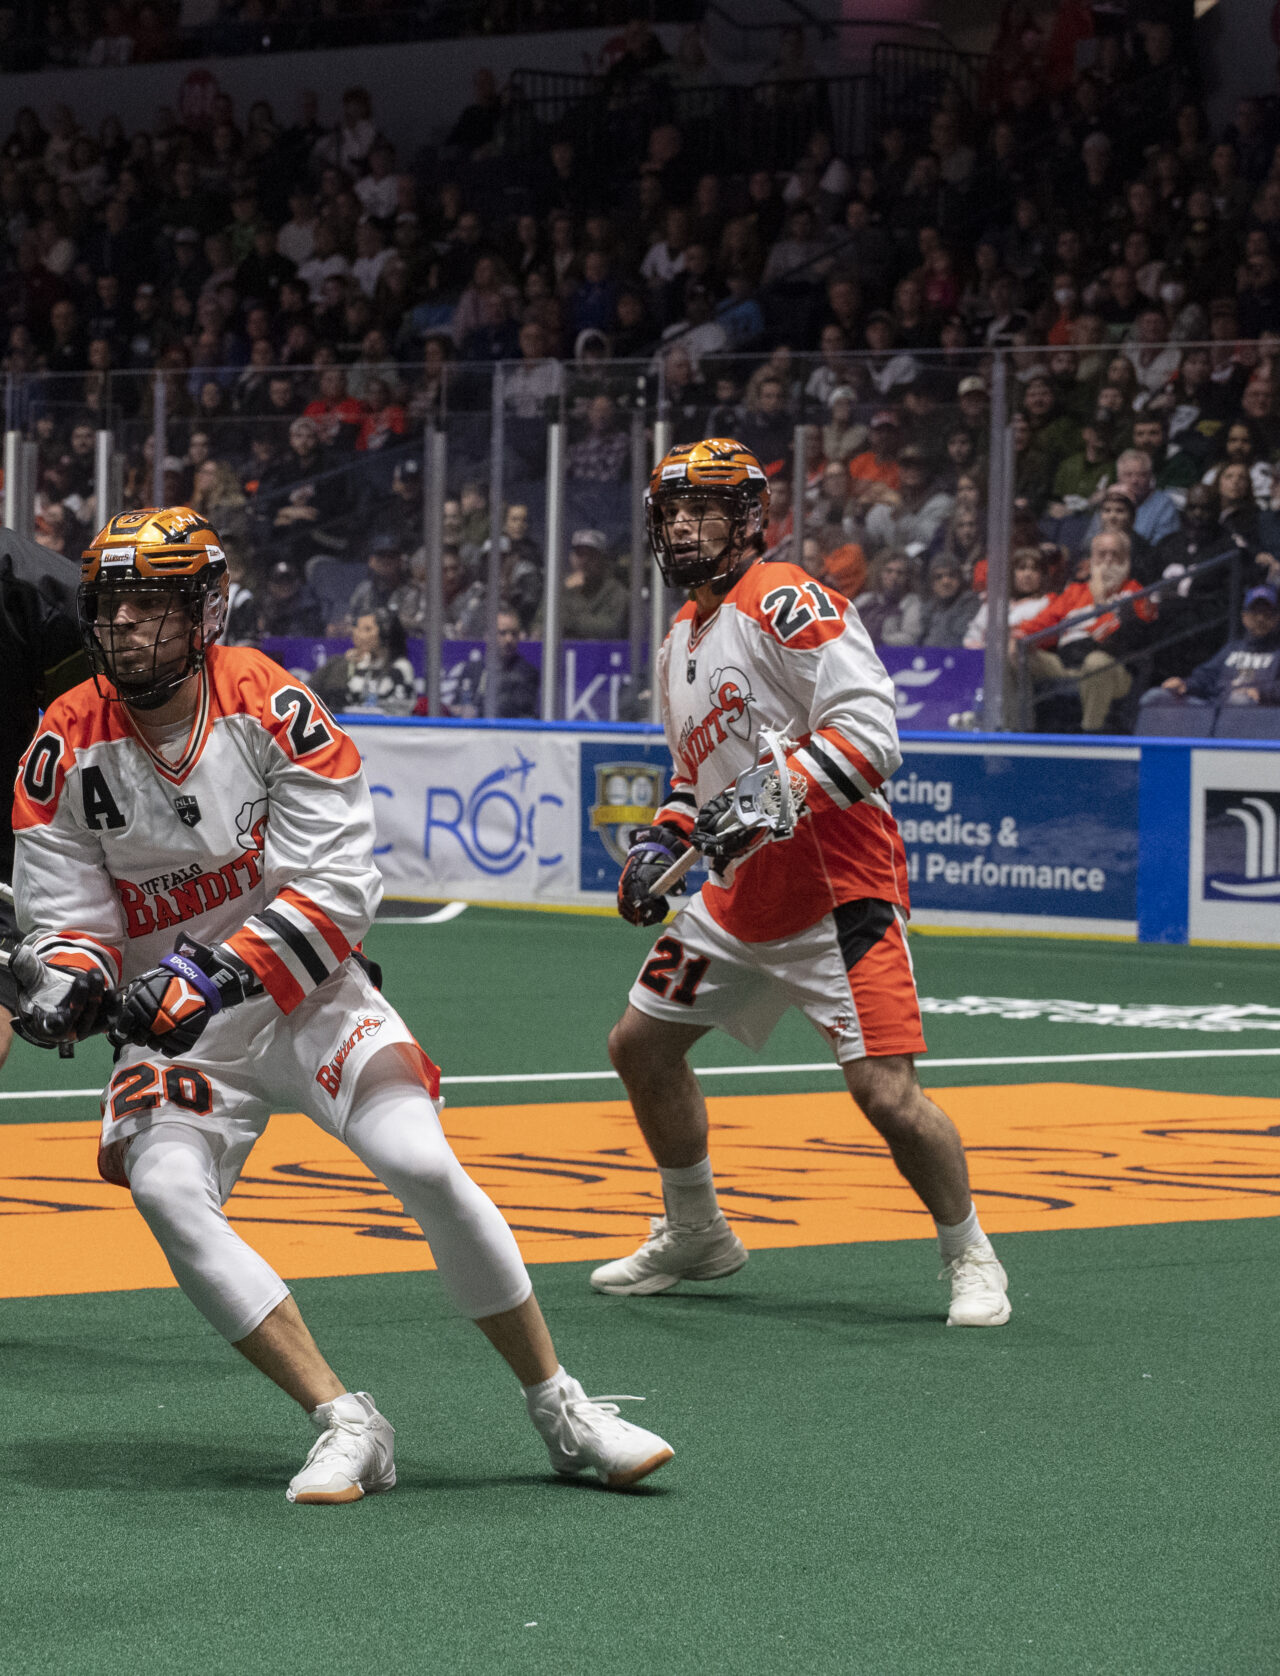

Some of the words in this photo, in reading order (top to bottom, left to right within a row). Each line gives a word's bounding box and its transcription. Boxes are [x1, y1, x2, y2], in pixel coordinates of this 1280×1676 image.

[760, 581, 840, 643] 21
[271, 685, 344, 759] 2
[22, 730, 65, 806] 0
[82, 765, 126, 830] A
[175, 797, 196, 807] NLL
[997, 815, 1019, 848] &
[926, 852, 1105, 892] Performance
[169, 955, 198, 980] EPOCH
[638, 935, 711, 1007] 21
[110, 1061, 214, 1122] 20
